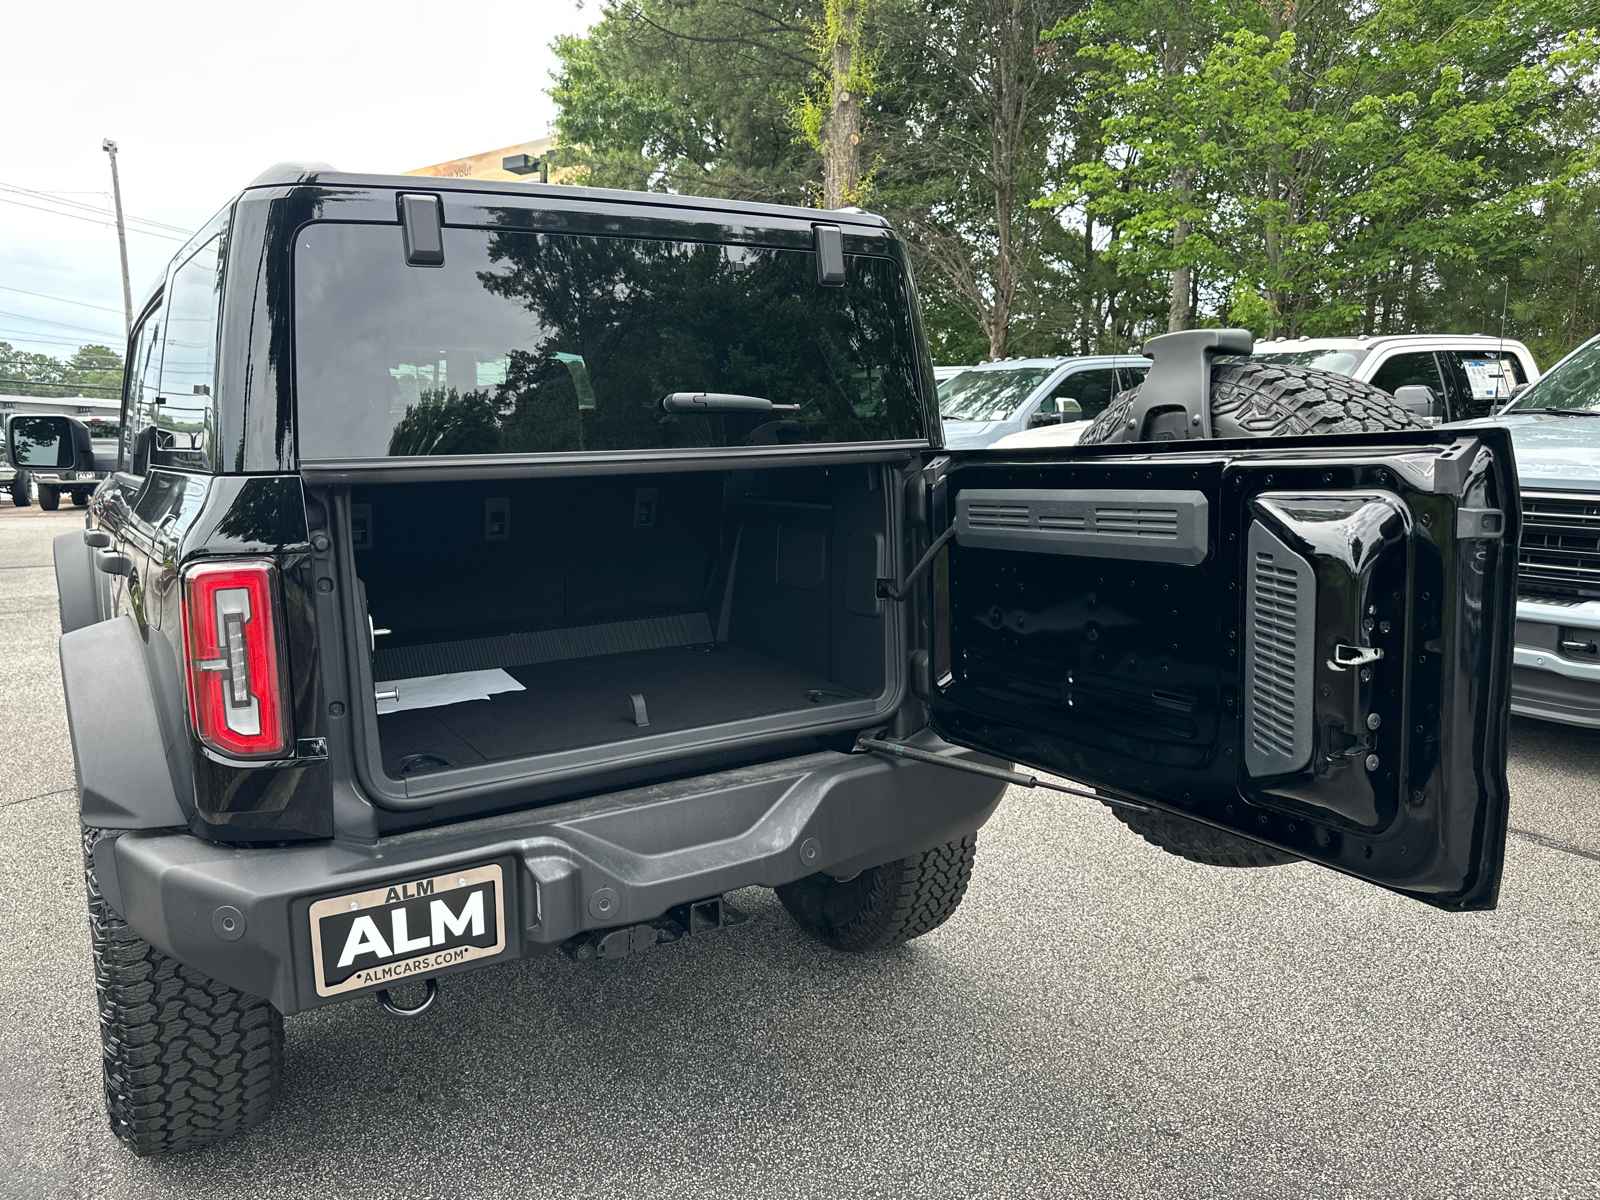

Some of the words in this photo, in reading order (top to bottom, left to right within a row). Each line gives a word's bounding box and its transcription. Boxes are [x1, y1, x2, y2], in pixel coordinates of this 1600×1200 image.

[385, 879, 435, 904] ALM
[336, 890, 486, 968] ALM
[363, 949, 465, 984] ALMCARS.COM
